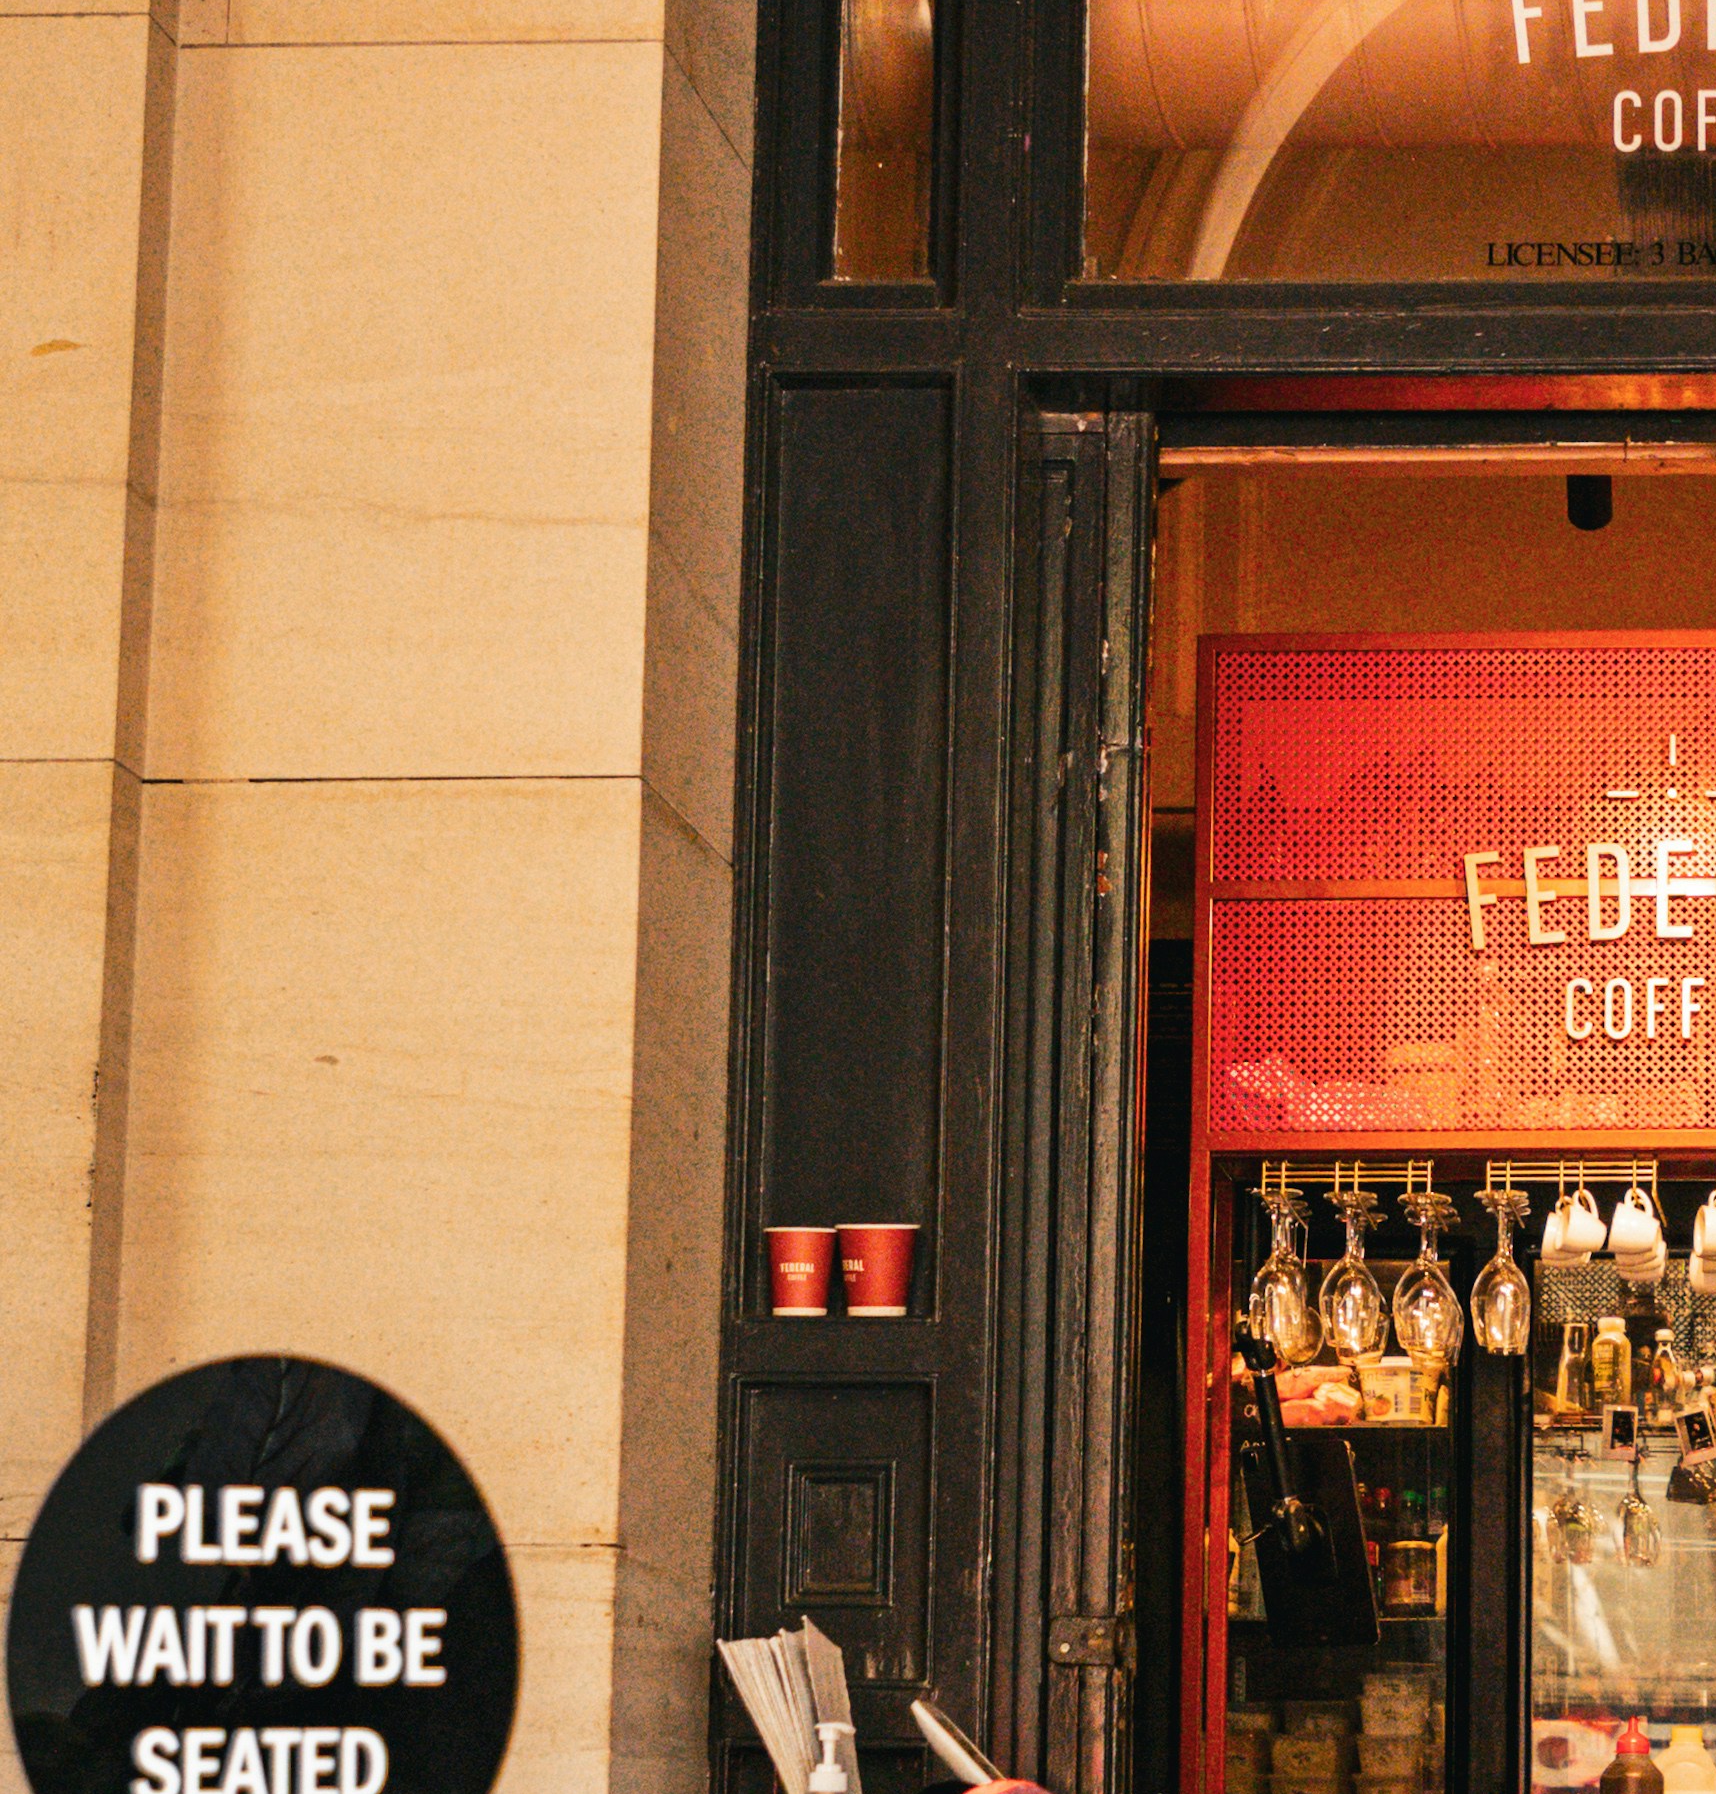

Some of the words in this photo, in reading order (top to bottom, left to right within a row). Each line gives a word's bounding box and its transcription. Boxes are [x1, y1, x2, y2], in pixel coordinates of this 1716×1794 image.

[1486, 241, 1640, 268] LICENSEE:
[1650, 241, 1666, 267] 3
[136, 1483, 396, 1568] PLEASE
[73, 1604, 247, 1687] WAIT
[250, 1606, 343, 1687] TO
[354, 1608, 448, 1687] BE
